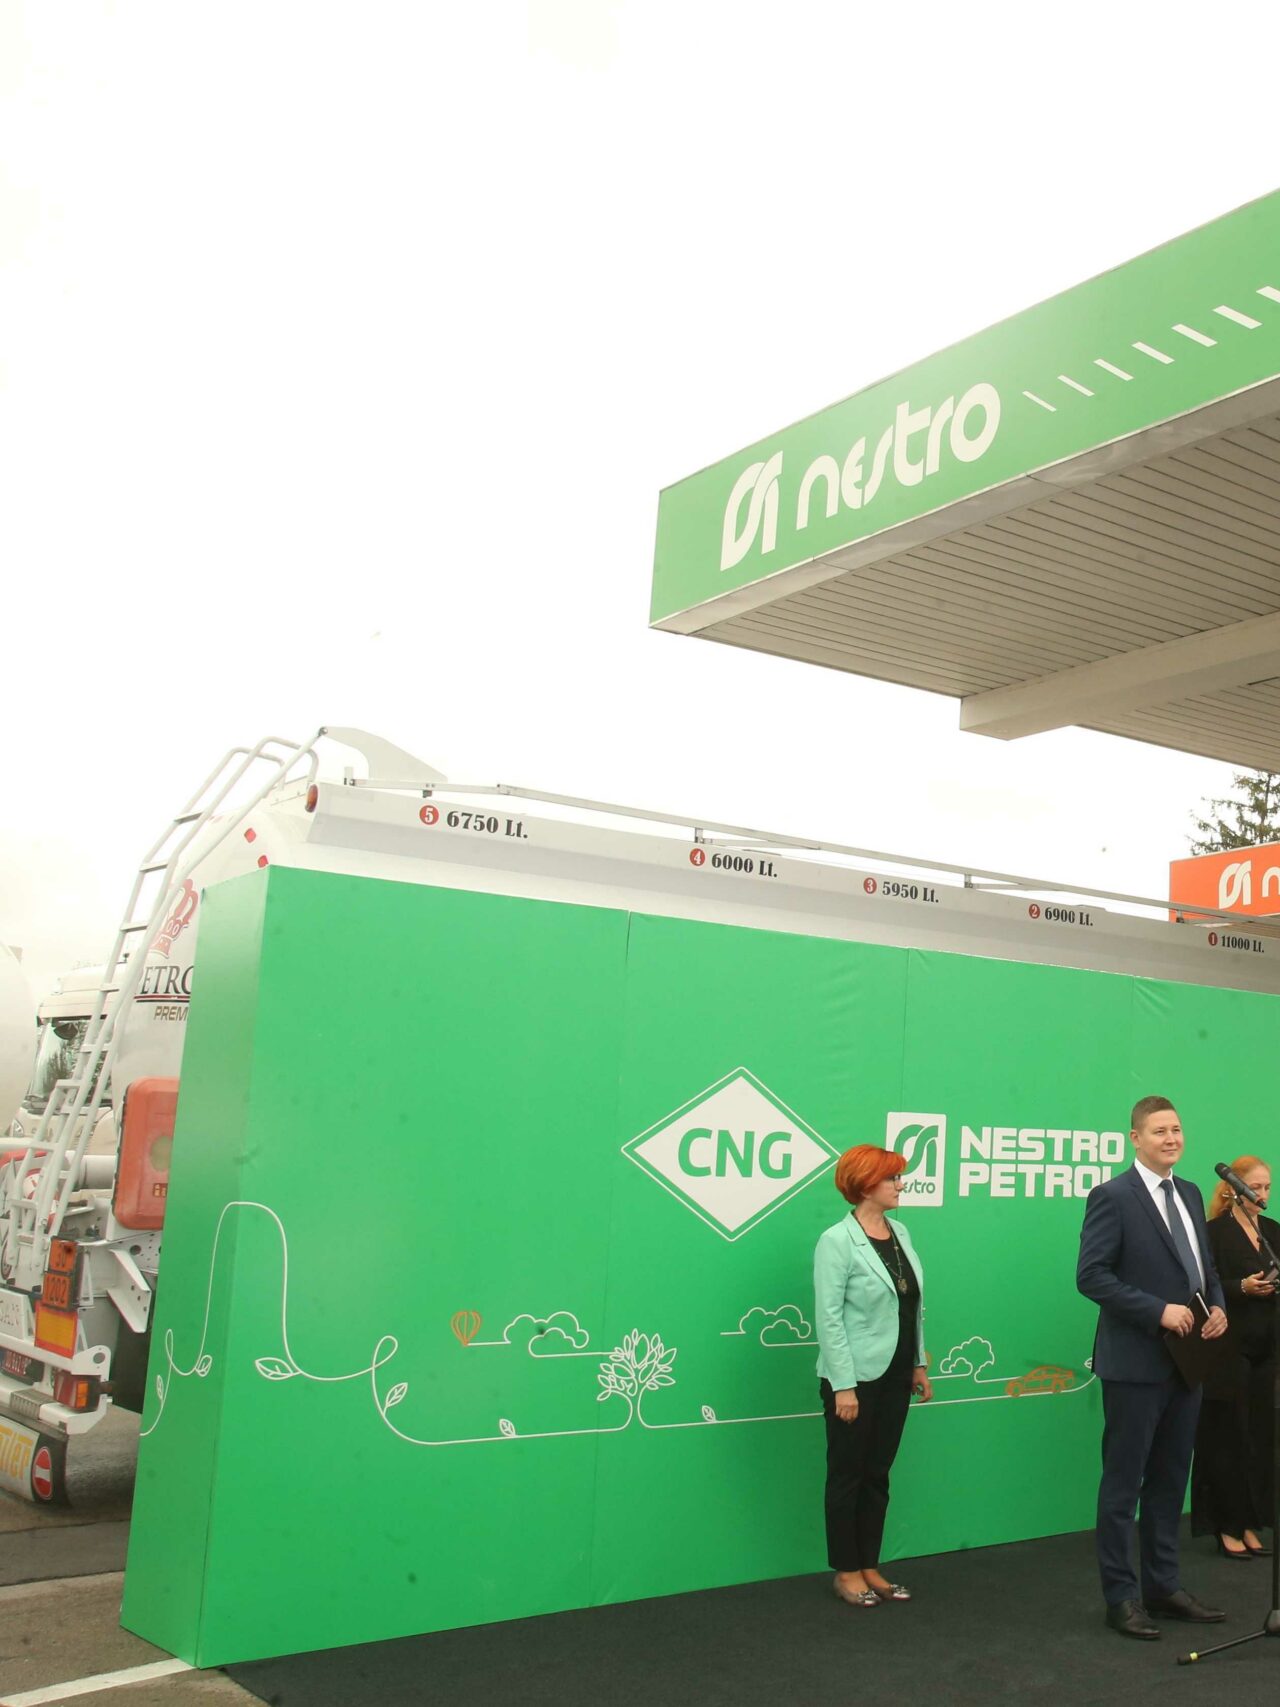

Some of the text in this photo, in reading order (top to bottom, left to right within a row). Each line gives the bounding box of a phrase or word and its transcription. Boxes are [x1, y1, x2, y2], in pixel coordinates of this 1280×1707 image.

[796, 382, 1001, 531] nestro
[423, 807, 528, 839] 5 6750 Lt.
[693, 850, 778, 878] 4 6000 Lt.
[866, 879, 939, 903] 3 5950 Lt.
[1031, 905, 1094, 926] 2 6900 Lt.
[1221, 935, 1250, 950] 11000
[1252, 941, 1265, 953] Lt.
[140, 965, 194, 995] ETRO
[153, 1005, 189, 1021] PREM
[678, 1127, 792, 1179] CNG
[960, 1125, 1125, 1163] NESTRO
[902, 1179, 936, 1194] estro
[46, 1275, 69, 1304] 1202
